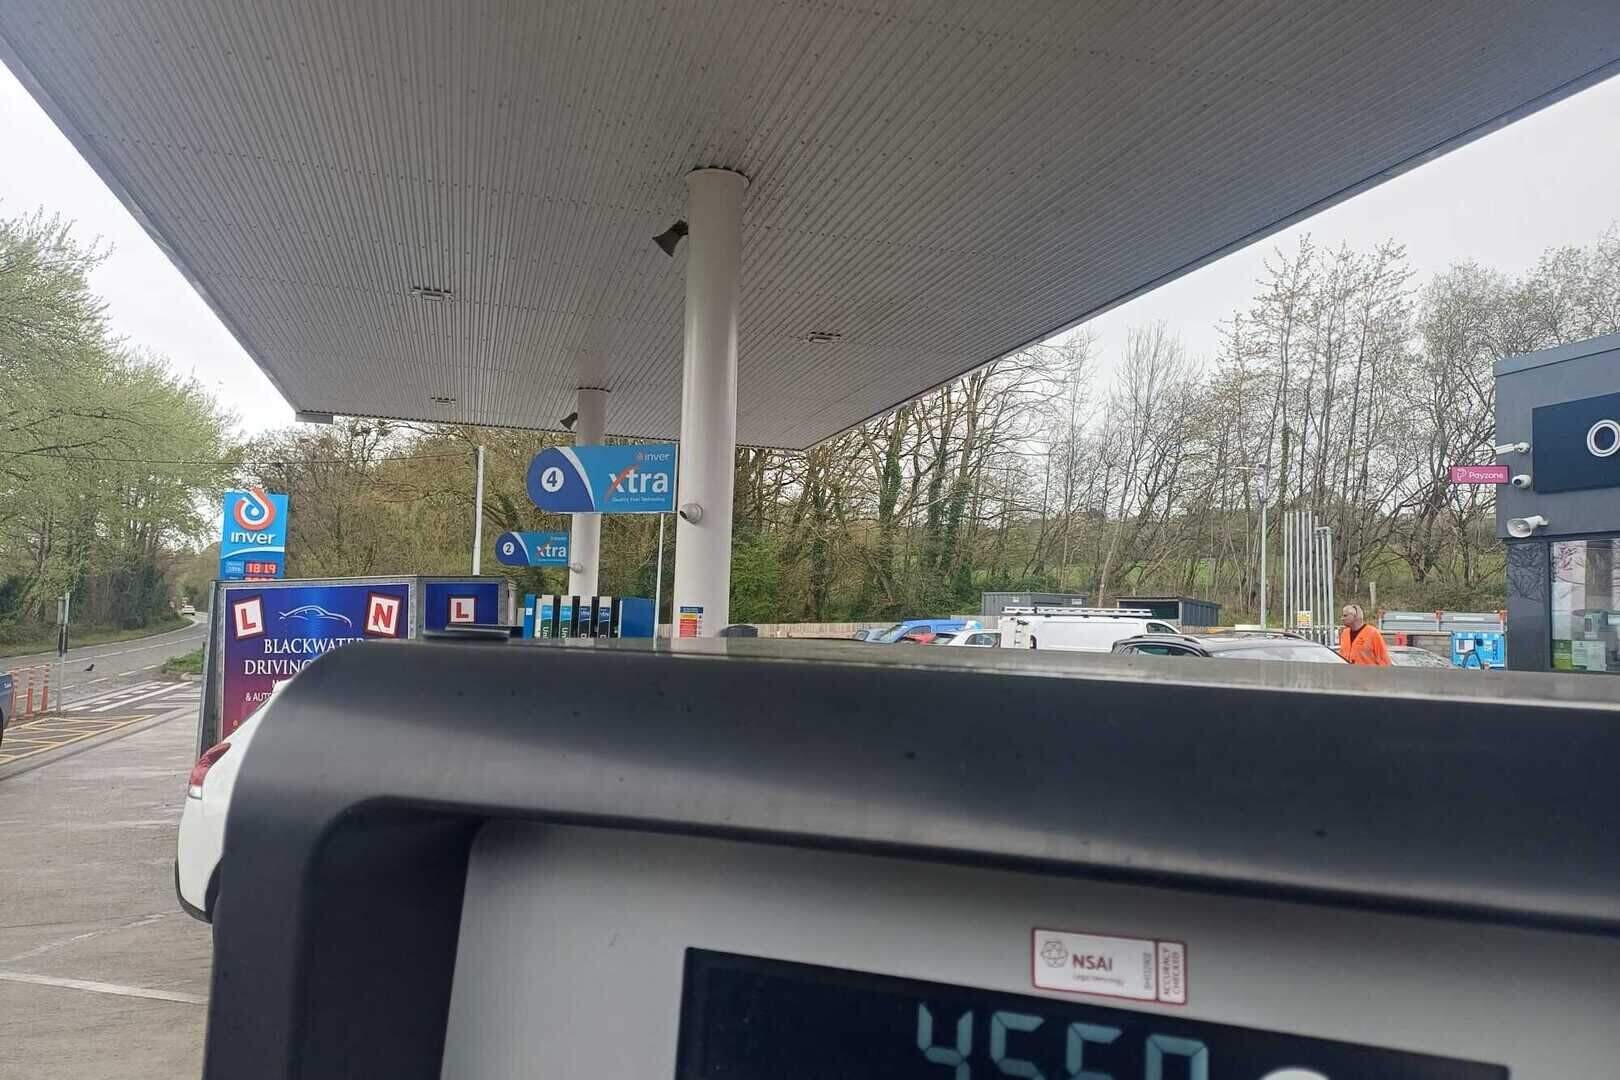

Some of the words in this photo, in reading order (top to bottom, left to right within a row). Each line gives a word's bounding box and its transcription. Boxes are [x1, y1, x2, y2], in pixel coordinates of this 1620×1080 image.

[644, 452, 670, 462] inver
[546, 470, 557, 487] 4
[607, 467, 668, 493] xtra
[1469, 471, 1504, 480] Payzone
[230, 531, 276, 544] inver
[505, 544, 512, 553] 2
[536, 544, 566, 557] xtra
[373, 603, 393, 628] N
[455, 602, 469, 618] L
[240, 608, 256, 630] L
[264, 638, 365, 654] BLACKWAT
[245, 692, 252, 702] &
[1072, 953, 1113, 971] NSAI
